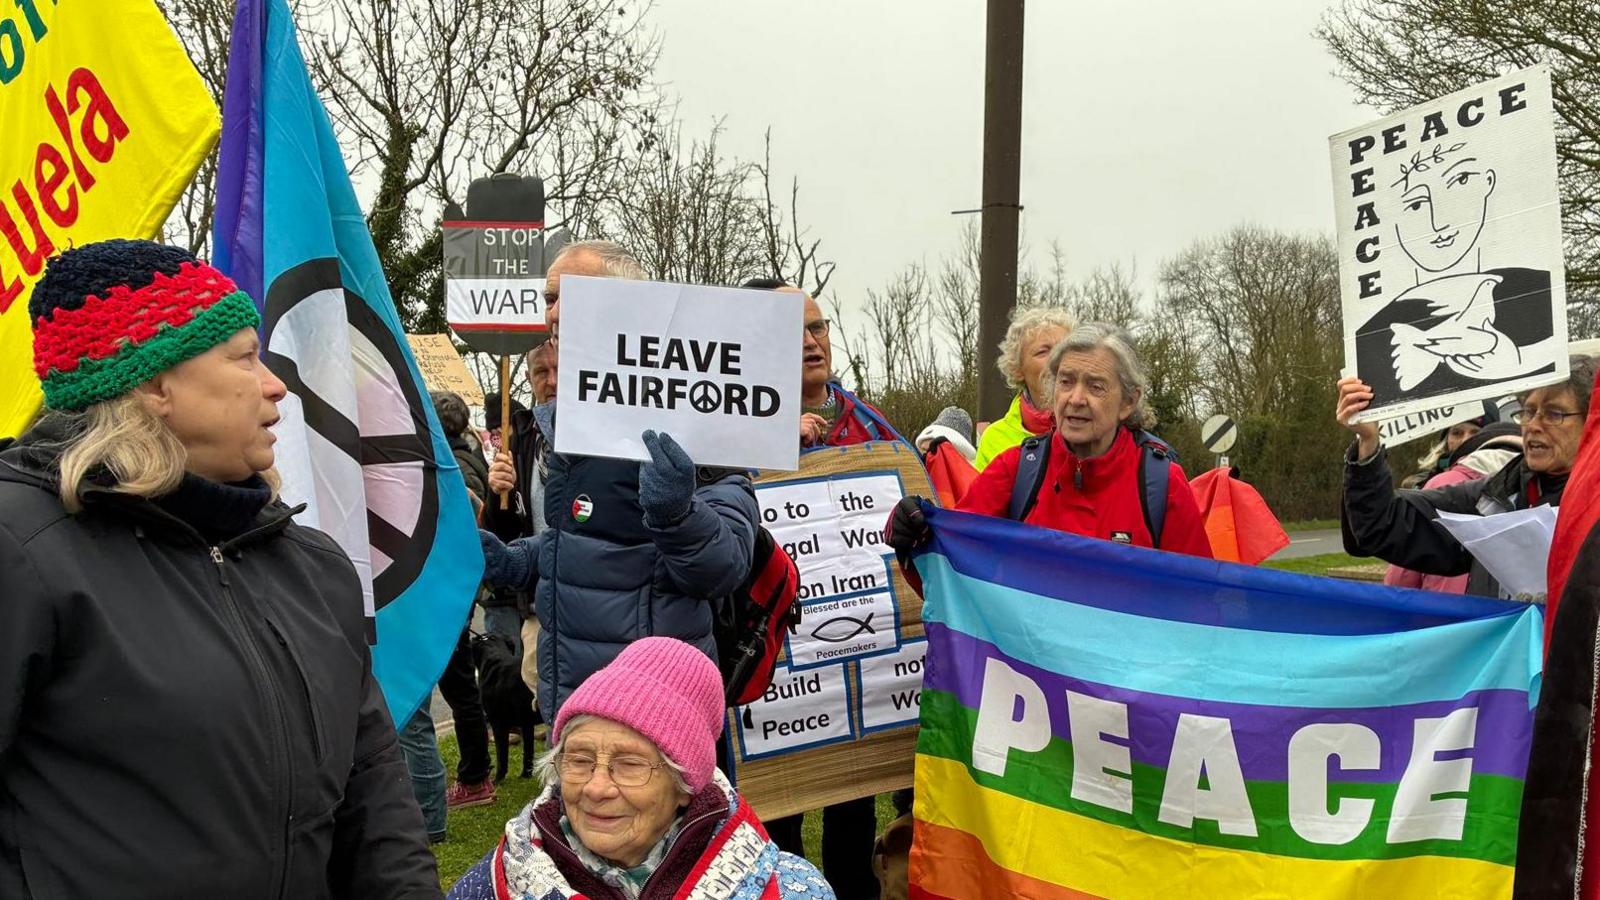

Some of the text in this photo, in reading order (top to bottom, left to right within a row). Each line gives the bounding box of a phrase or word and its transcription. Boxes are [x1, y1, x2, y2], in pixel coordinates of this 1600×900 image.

[1348, 83, 1527, 166] PEACE
[484, 228, 541, 246] STOP
[492, 259, 529, 275] THE
[470, 289, 538, 315] WAR
[617, 333, 742, 375] LEAVE
[578, 370, 781, 417] FAIRFORD
[784, 501, 810, 519] to
[840, 491, 874, 512] the
[840, 528, 886, 549] War
[799, 573, 876, 600] on Iran
[803, 596, 875, 615] Blessed are the
[816, 641, 877, 660] Peacemakers
[763, 673, 822, 703] Build
[762, 713, 830, 740] Peace
[972, 656, 1478, 844] PEACE
